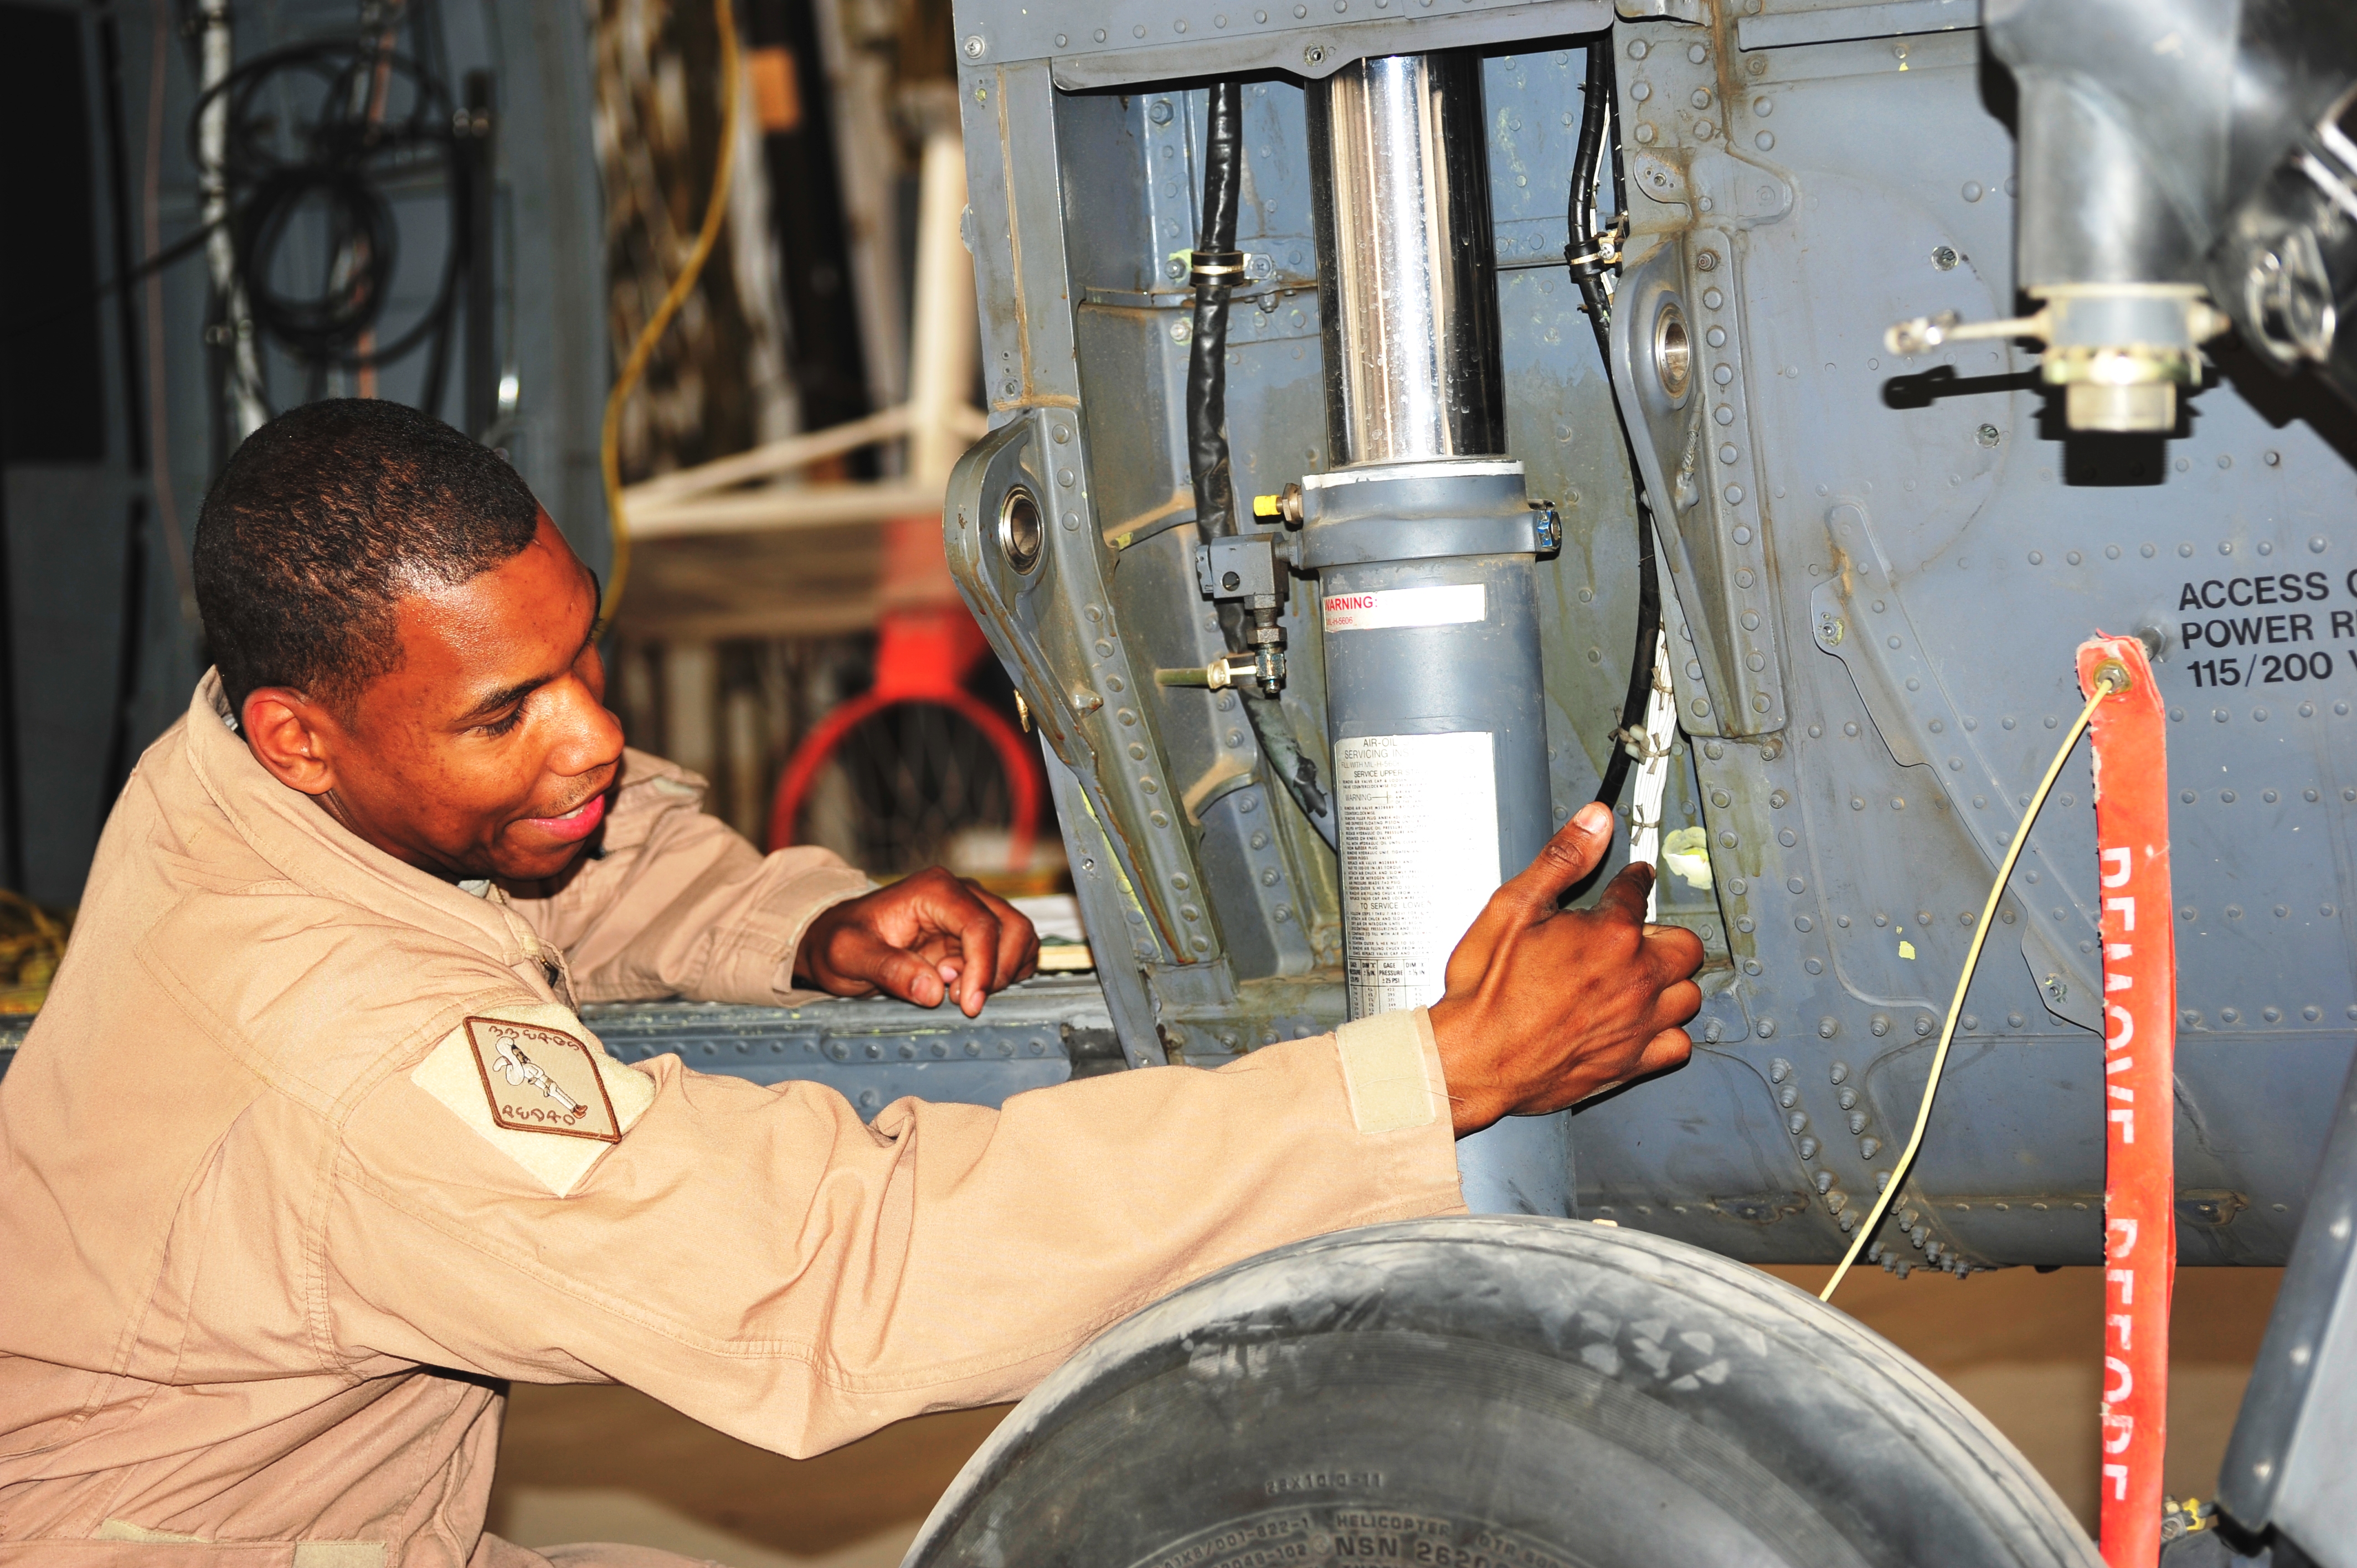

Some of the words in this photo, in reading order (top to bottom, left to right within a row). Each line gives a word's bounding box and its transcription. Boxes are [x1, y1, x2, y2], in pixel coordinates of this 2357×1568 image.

[2179, 571, 2330, 611] ACCESS
[1324, 596, 1377, 611] WARNING:
[2181, 613, 2314, 649] POWER
[2187, 651, 2334, 688] 115/200
[1363, 738, 1398, 747] AIR-OIL
[1345, 749, 1388, 759] SERVICING
[488, 1025, 519, 1039] 33
[523, 1029, 579, 1051] ERQS
[502, 1105, 575, 1126] PEDRO
[1337, 1513, 1450, 1536] HELICOPTER
[1335, 1536, 1398, 1557] NSN
